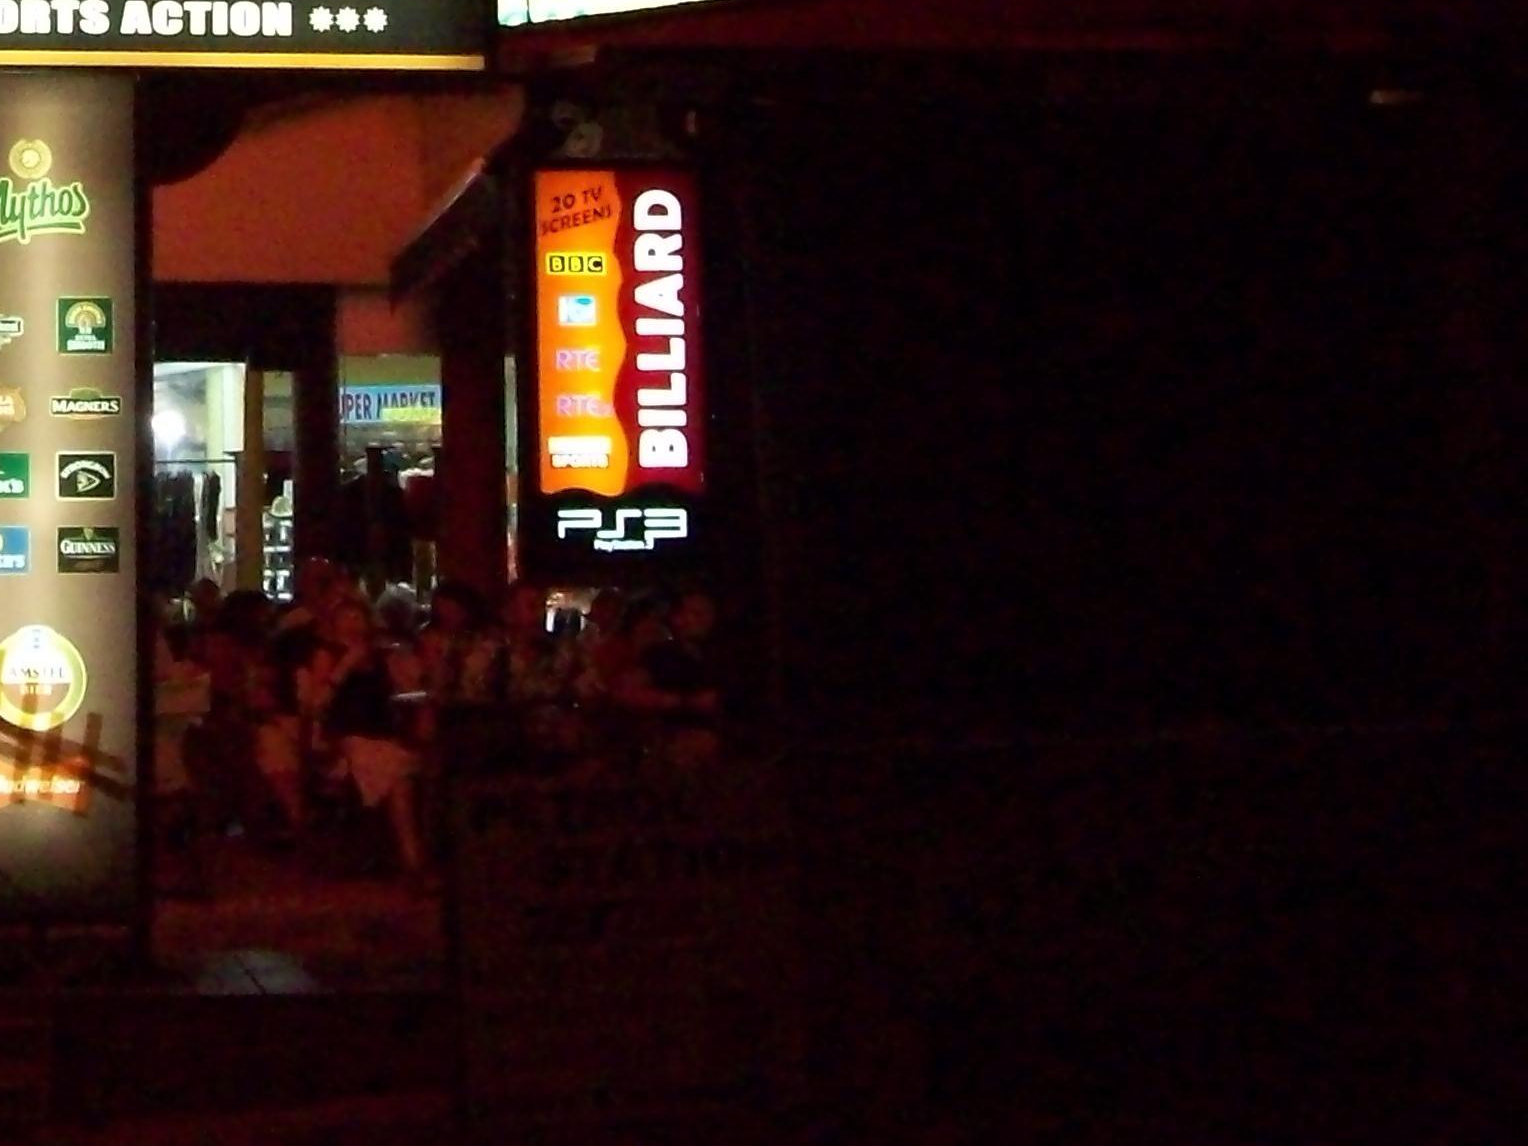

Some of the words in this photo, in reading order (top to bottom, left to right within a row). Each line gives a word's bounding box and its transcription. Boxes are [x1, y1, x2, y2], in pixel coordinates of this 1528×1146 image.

[120, 0, 292, 37] ACTION
[550, 194, 576, 213] 20
[582, 185, 604, 204] TV
[540, 204, 613, 236] SCREENS
[549, 255, 604, 273] BBC
[633, 189, 688, 468] BILLIARD
[52, 400, 119, 413] MAGNERS
[557, 508, 688, 546] PS3
[60, 539, 116, 555] GUINNESS
